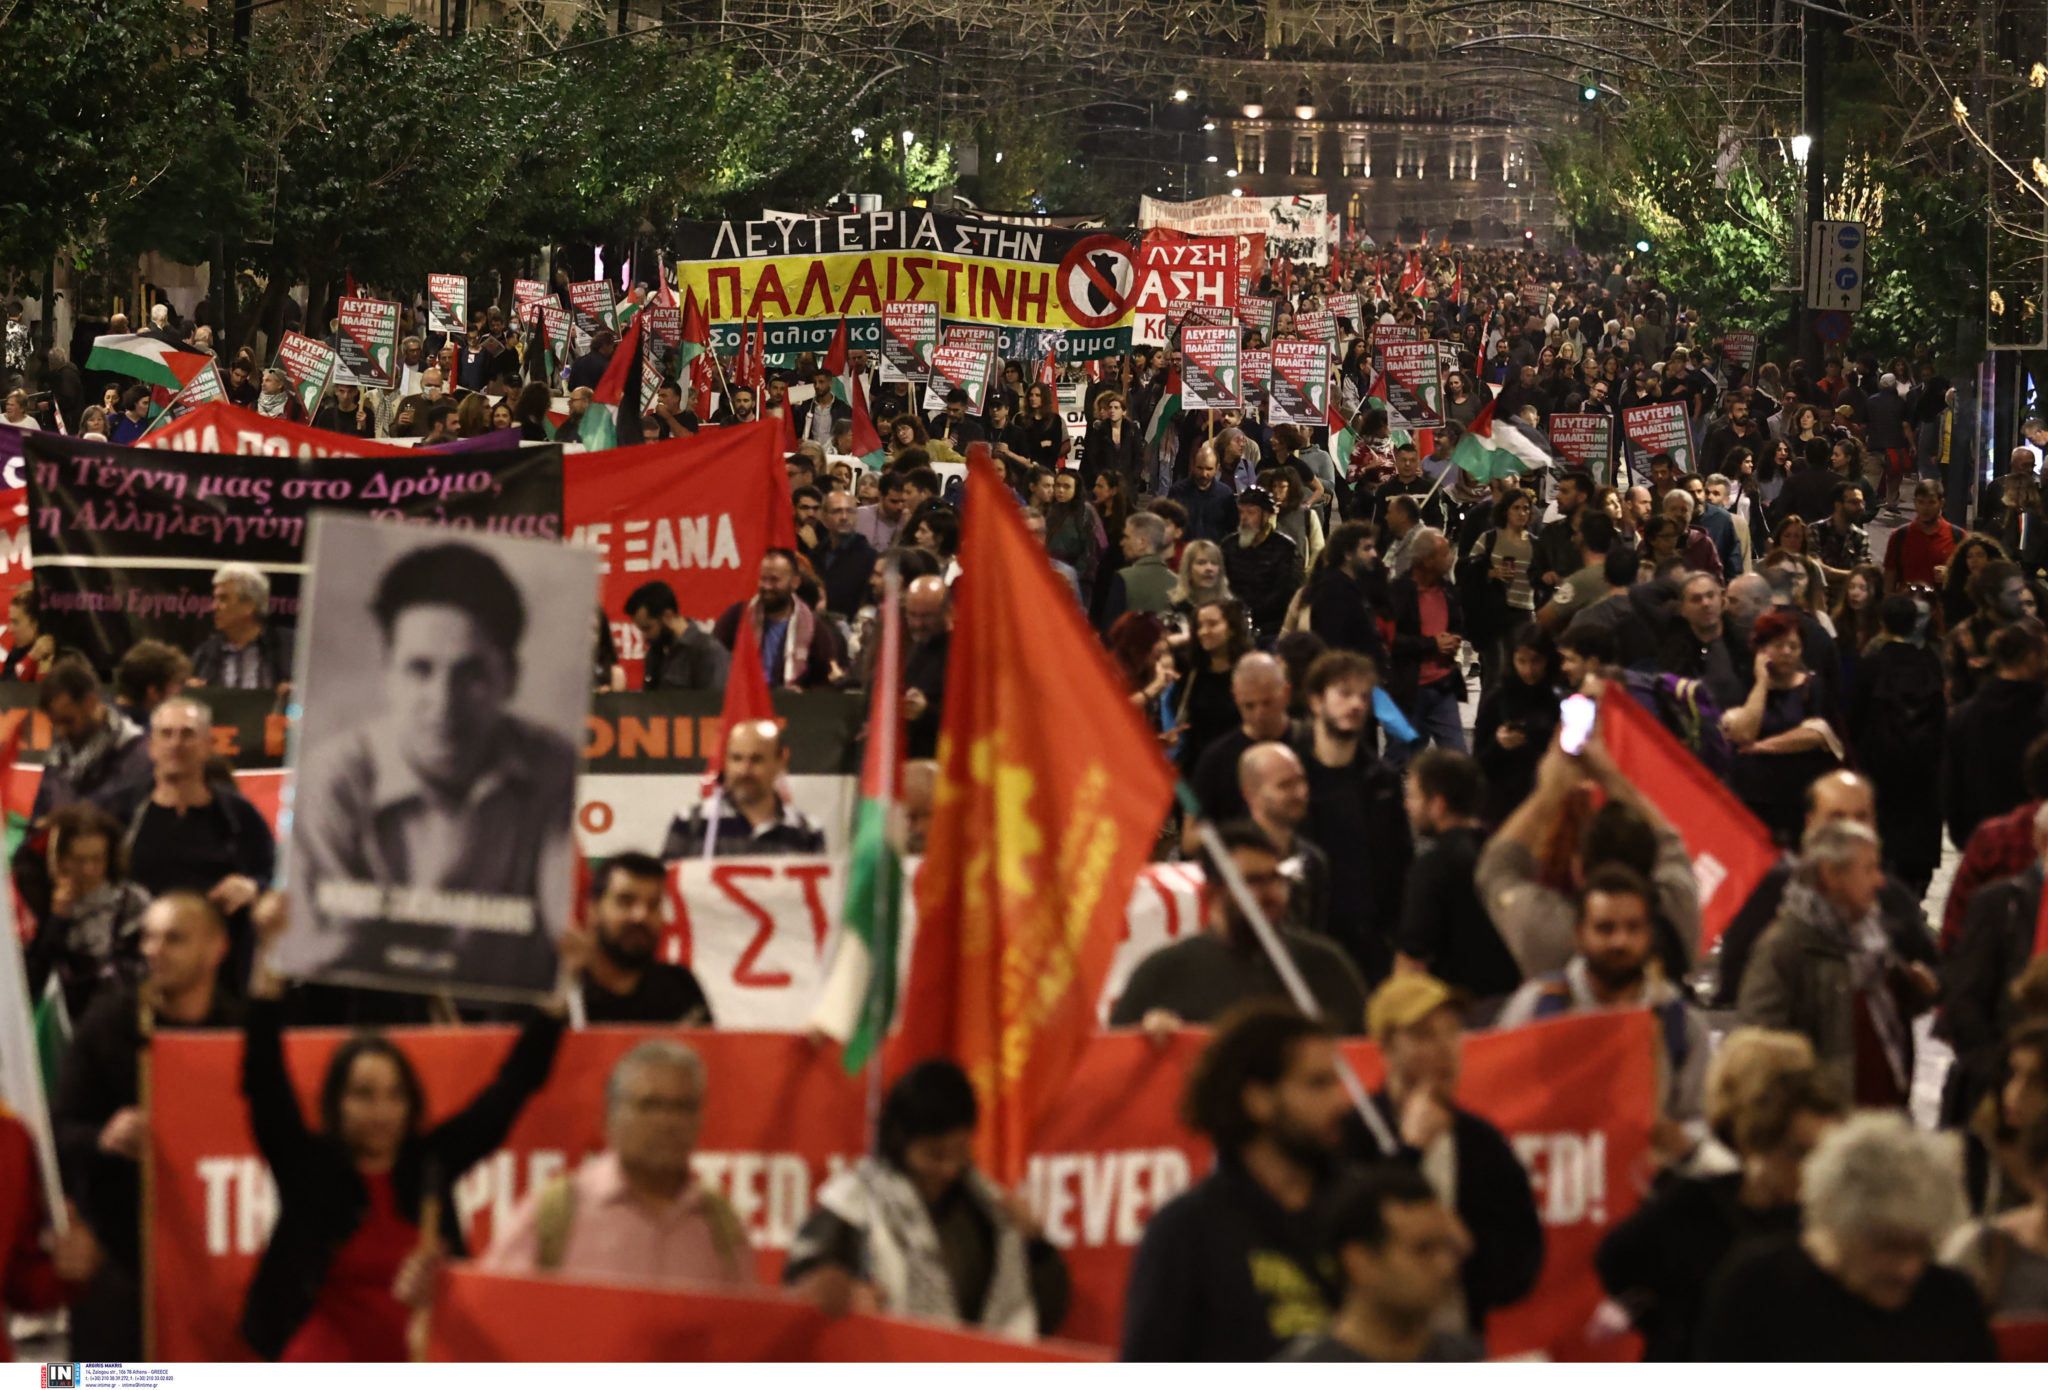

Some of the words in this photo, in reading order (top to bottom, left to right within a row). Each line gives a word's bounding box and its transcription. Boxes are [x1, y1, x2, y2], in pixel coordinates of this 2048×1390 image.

[711, 210, 942, 258] ΛΕΥΤΕΡΙΑ
[954, 224, 1043, 261] ΣΤΗΝ
[432, 276, 464, 286] ΛΕΥΤΕΡΙΑ
[572, 282, 610, 294] ΛΕΥΤΕΡΙΑ
[708, 256, 1049, 323] ΠΑΛΑΙΣΤΙΝΗ
[573, 293, 610, 304] ΠΑΛΑΙΣΤΙΝΗ
[343, 301, 396, 316] ΛΕΥΤΕΡΙΑ
[886, 303, 936, 314] ΛΕΥΤΕΡΙΑ
[886, 318, 936, 326] ΠΑΛΑΙΣΤΙΝΗ
[1296, 311, 1333, 321] ΛΕΥΤΕΡΙΑ
[341, 316, 394, 330] ΠΑΛΑΙΣΤΙΝΗ
[710, 323, 880, 347] Σοσιαλιστκό
[950, 328, 995, 339] ΛΕΥΤΕΡΙΑ
[1186, 329, 1236, 340] ΛΕΥΤΕΡΙΑ
[1376, 326, 1416, 336] ΛΕΥΤΕΡΙΑ
[286, 335, 334, 361] ΛΕΥΤΕΡΙΑ
[937, 348, 988, 360] ΛΕΥΤΕΡΙΑ
[1185, 344, 1236, 353] ΠΑΛΑΙΣΤΙΝΗ
[1276, 343, 1325, 355] ΛΕΥΤΕΡΙΑ
[1387, 344, 1435, 356] ΛΕΥΤΕΡΙΑ
[281, 348, 330, 374] ΠΑΛΑΙΣΤΙΝΗ
[935, 359, 986, 370] ΠΑΛΑΙΣΤΙΝΗ
[1275, 358, 1325, 368] ΠΑΛΑΙΣΤΙΝΗ
[1387, 359, 1436, 370] ΠΑΛΑΙΣΤΙΝΗ
[1628, 405, 1683, 422] ΛΕΥΤΕΡΙΑ
[1554, 418, 1608, 428] ΛΕΥΤΕΡΙΑ
[1629, 420, 1685, 437] ΠΑΛΑΙΣΤΙΝΗ
[1554, 434, 1608, 442] ΠΑΛΑΙΣΤΙΝΗ
[35, 460, 59, 492] η
[72, 456, 189, 499] Τέχνη
[196, 474, 275, 505] μας
[280, 478, 352, 500] στο
[359, 466, 502, 504] Δρόμο,
[37, 505, 62, 538] η
[69, 500, 304, 547] Αλληλεγγύη
[624, 512, 740, 573] ΞΑΝΑ
